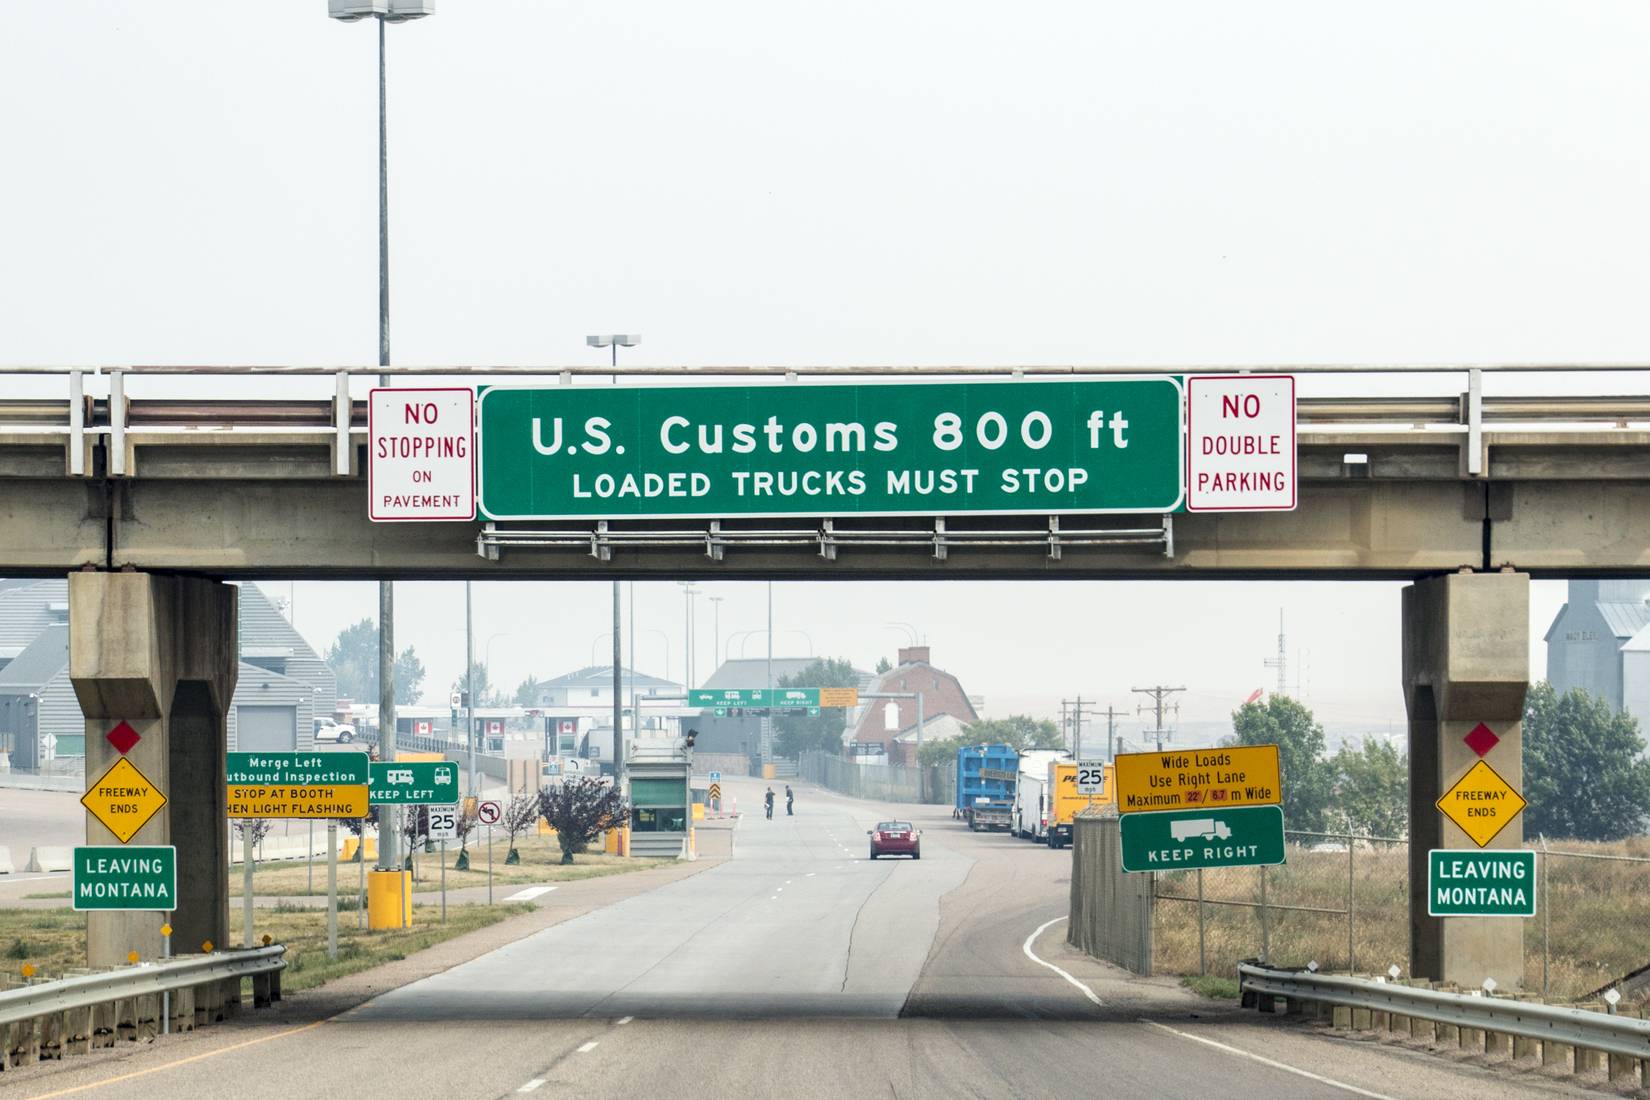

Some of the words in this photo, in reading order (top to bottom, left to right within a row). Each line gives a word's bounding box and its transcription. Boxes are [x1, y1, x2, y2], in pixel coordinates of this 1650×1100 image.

[405, 402, 439, 425] NO
[1222, 393, 1260, 419] NO
[531, 416, 627, 456] U.S.
[659, 415, 898, 454] Customs
[932, 410, 1053, 451] 800
[1086, 410, 1129, 449] ft
[378, 436, 467, 459] STOPPING
[1202, 435, 1281, 455] DOUBLE
[412, 470, 432, 483] ON
[572, 472, 712, 498] LOADED
[731, 470, 867, 496] TRUCKS
[887, 469, 979, 495] MUST
[1000, 468, 1089, 494] STOP
[1198, 471, 1286, 493] PARKING
[383, 494, 461, 508] PAVEMENT
[249, 758, 289, 770] Merge
[295, 757, 322, 768] Left
[1161, 755, 1189, 769] Wide
[1195, 753, 1231, 768] Loads
[226, 772, 280, 782] utbound
[285, 772, 356, 783] Inspection
[1079, 770, 1102, 785] 25
[1149, 774, 1173, 788] Use
[1178, 772, 1211, 789] Right
[1217, 770, 1246, 784] Lane
[99, 787, 149, 798] FREEWAY
[234, 789, 266, 798] STOP
[270, 789, 285, 798] AT
[290, 789, 334, 798] BOOTH
[369, 790, 400, 799] KEEP
[405, 790, 434, 799] LEFT
[1127, 792, 1181, 807] Maximum
[1231, 790, 1242, 800] m
[1245, 786, 1271, 800] Wide
[1456, 791, 1507, 801] FREEWAY
[110, 804, 138, 814] ENDS
[227, 804, 249, 814] HEN
[253, 804, 288, 814] LIGHT
[291, 804, 353, 814] FLASHING
[1467, 807, 1496, 817] ENDS
[431, 815, 455, 830] 25
[1148, 849, 1194, 863] KEEP
[1203, 845, 1258, 860] RIGHT
[86, 858, 163, 874] LEAVING
[1439, 861, 1525, 879] LEAVING
[80, 882, 169, 899] MONTANA
[1437, 888, 1526, 906] MONTANA
